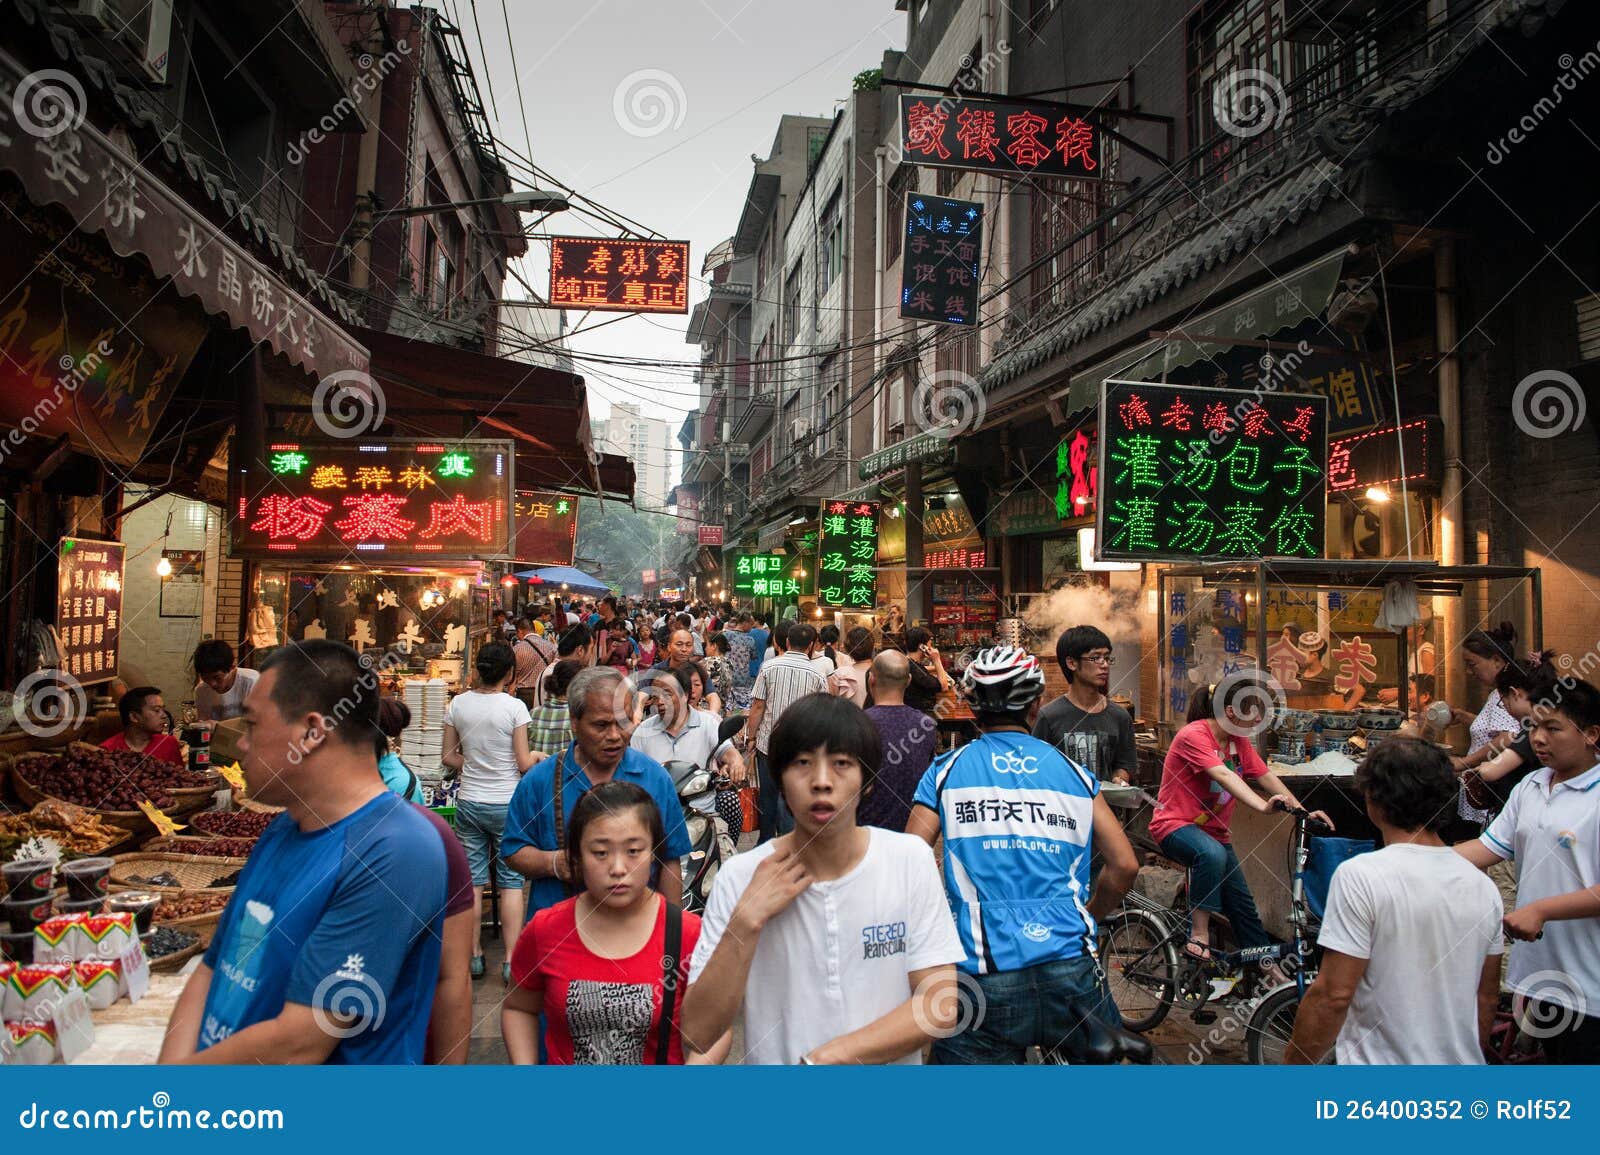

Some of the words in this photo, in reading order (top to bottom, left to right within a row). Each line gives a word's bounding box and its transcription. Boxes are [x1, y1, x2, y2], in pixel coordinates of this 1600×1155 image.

[1111, 434, 1319, 495] 灌汤包子
[250, 493, 493, 542] 粉蒸肉
[1109, 496, 1316, 555] 灌汤蒸饺
[736, 578, 800, 596] 一碗回头
[955, 799, 1046, 824] 骑行天下
[862, 921, 906, 944] STEREO
[1241, 946, 1270, 956] GIANT
